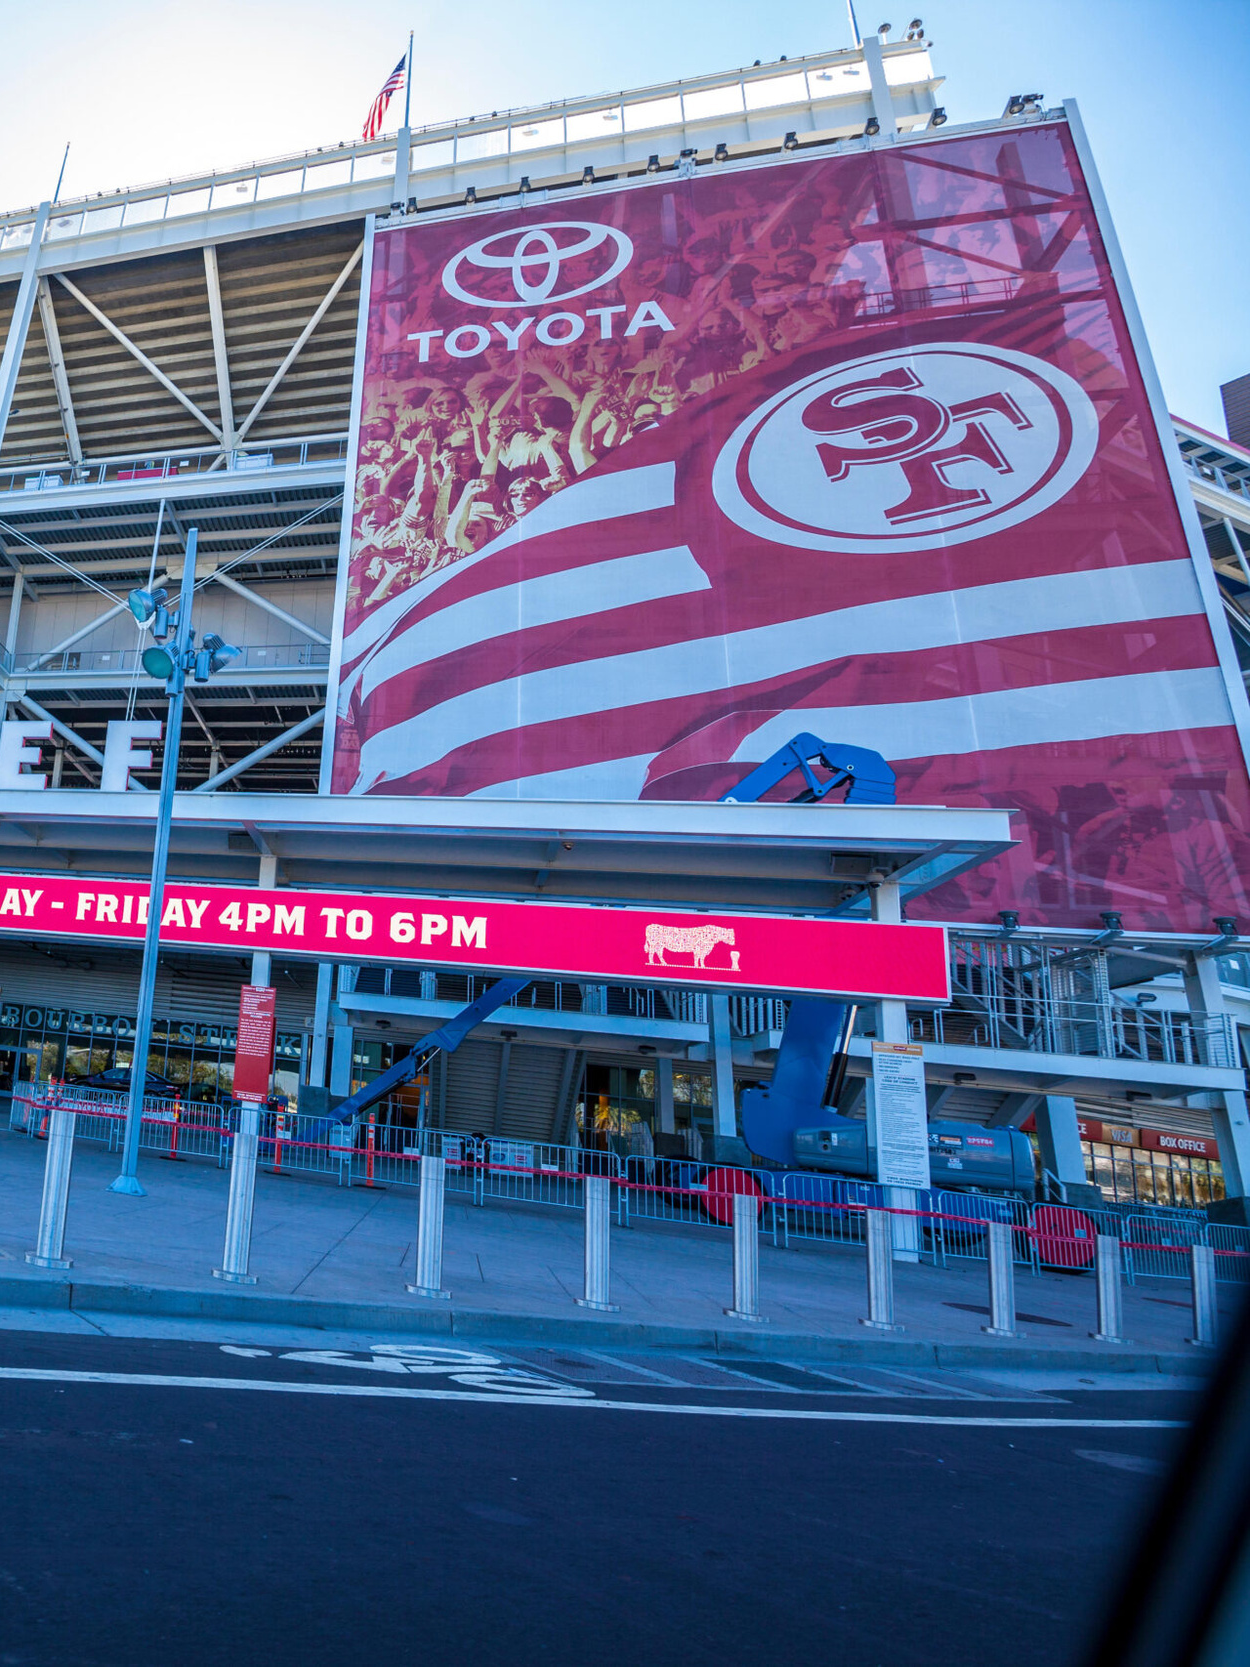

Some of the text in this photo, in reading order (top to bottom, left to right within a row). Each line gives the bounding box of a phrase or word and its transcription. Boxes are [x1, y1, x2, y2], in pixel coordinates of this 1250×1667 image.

[407, 301, 677, 363] TOYOTA
[100, 720, 163, 791] F
[75, 892, 211, 928] FRIDAY
[218, 901, 306, 936] 4PM
[319, 907, 373, 941] TO
[389, 911, 488, 949] 6PM
[4, 1006, 155, 1038] BOURBO
[179, 1023, 300, 1056] STEK
[1111, 1128, 1133, 1143] VISA
[1160, 1135, 1206, 1153] BOX OFFICE
